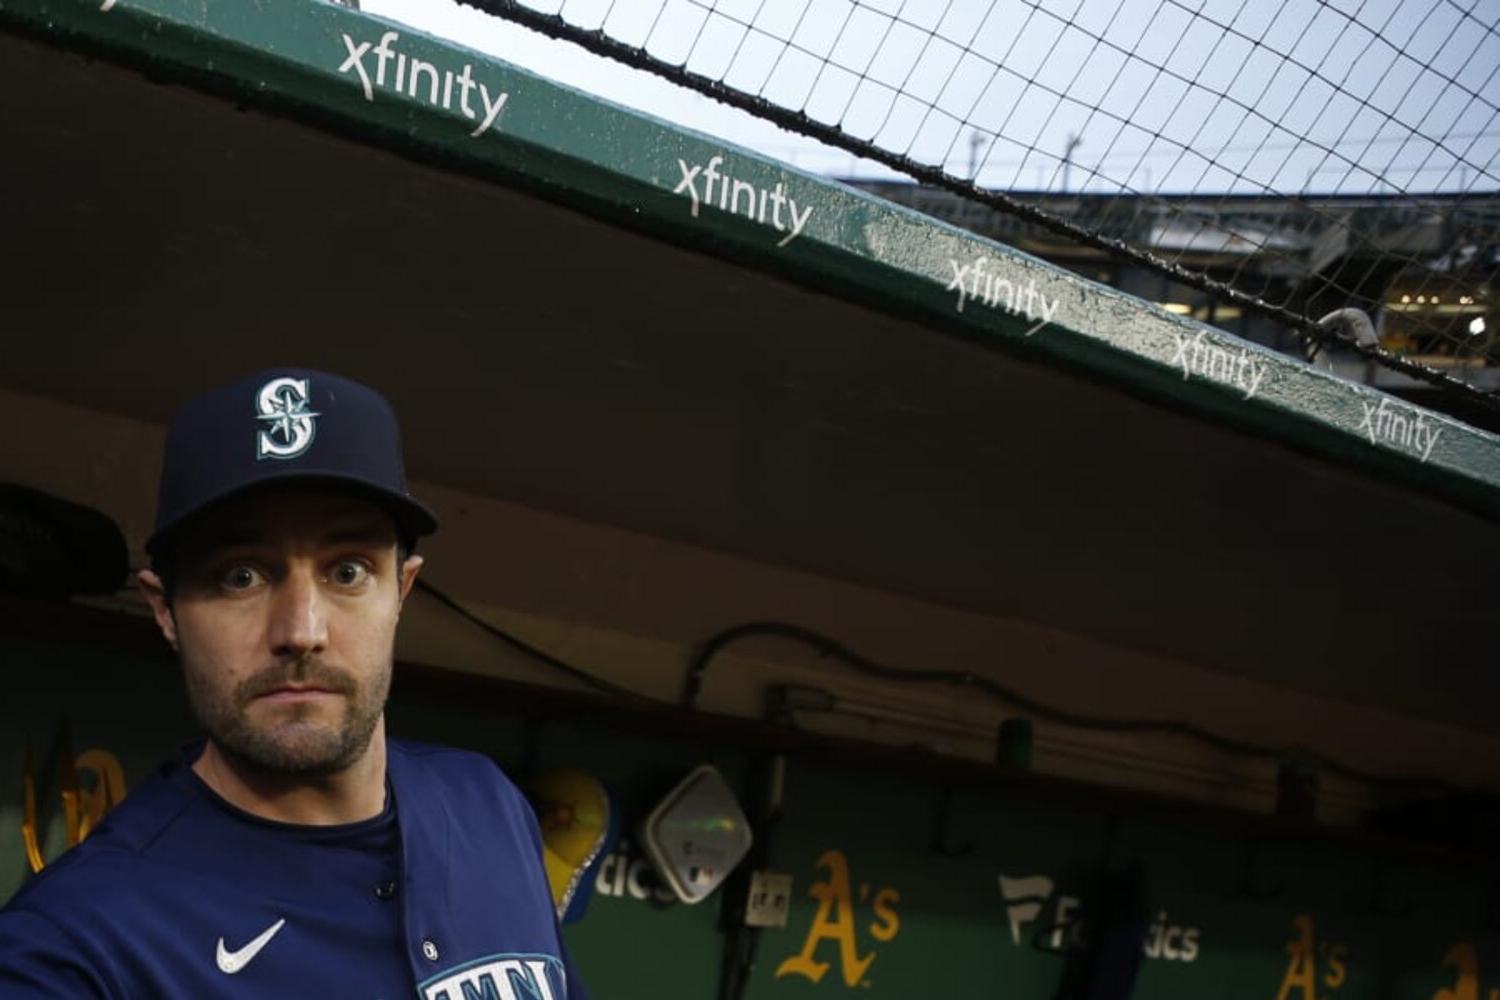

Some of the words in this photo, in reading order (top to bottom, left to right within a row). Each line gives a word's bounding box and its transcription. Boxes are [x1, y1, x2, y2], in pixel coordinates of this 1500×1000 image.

[337, 32, 508, 137] xfinity
[673, 156, 813, 247] xfinity
[946, 257, 1060, 336] xfinity
[1171, 329, 1266, 400] xfinity
[257, 377, 320, 460] S
[1358, 398, 1443, 463] xfinity
[775, 850, 900, 988] A's
